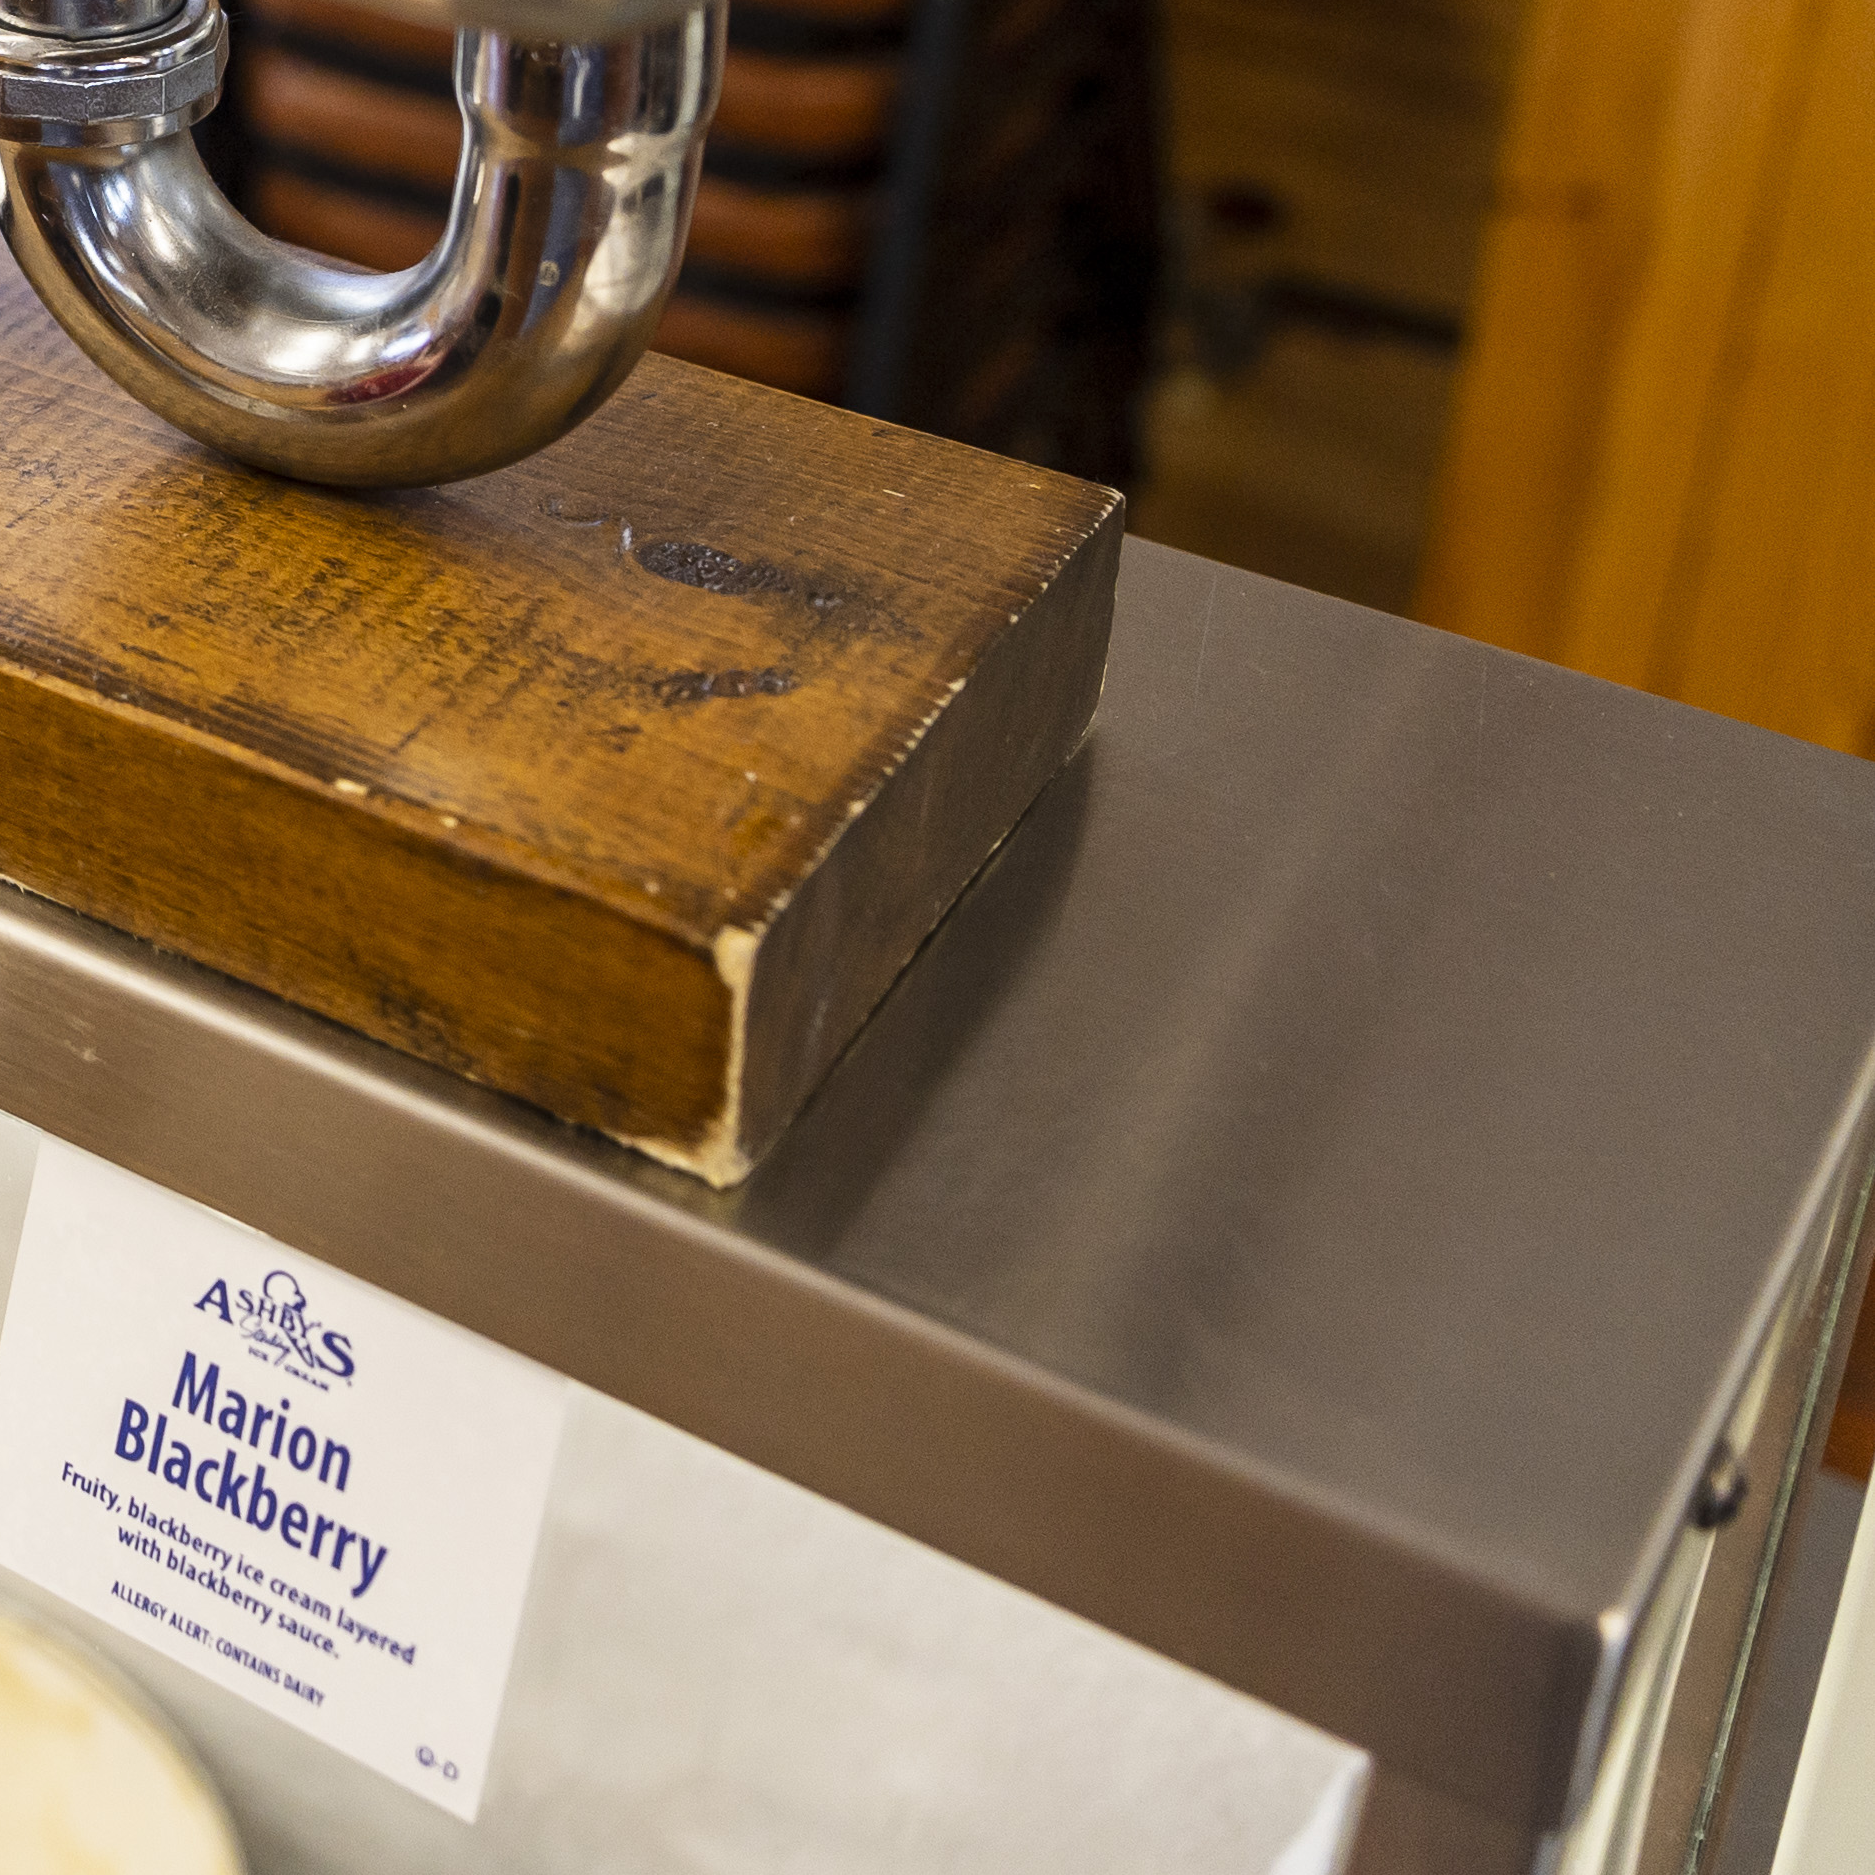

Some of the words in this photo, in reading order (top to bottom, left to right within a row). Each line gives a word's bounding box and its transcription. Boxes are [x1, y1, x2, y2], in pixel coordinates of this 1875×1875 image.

[172, 1351, 351, 1492] Marion
[61, 1461, 122, 1514] Fruity,
[127, 1496, 233, 1571] blackberry
[237, 1554, 264, 1585] ice
[270, 1578, 332, 1622] cream
[337, 1607, 417, 1666] layered
[114, 1397, 388, 1599] Blackberry
[111, 1580, 168, 1621] ALLERGY
[168, 1612, 214, 1649] ALERT:
[215, 1637, 281, 1685] CONTAINS
[283, 1673, 326, 1708] DAIRY
[118, 1525, 162, 1563] with
[166, 1548, 273, 1625] blackberry
[278, 1613, 340, 1659] sauce.
